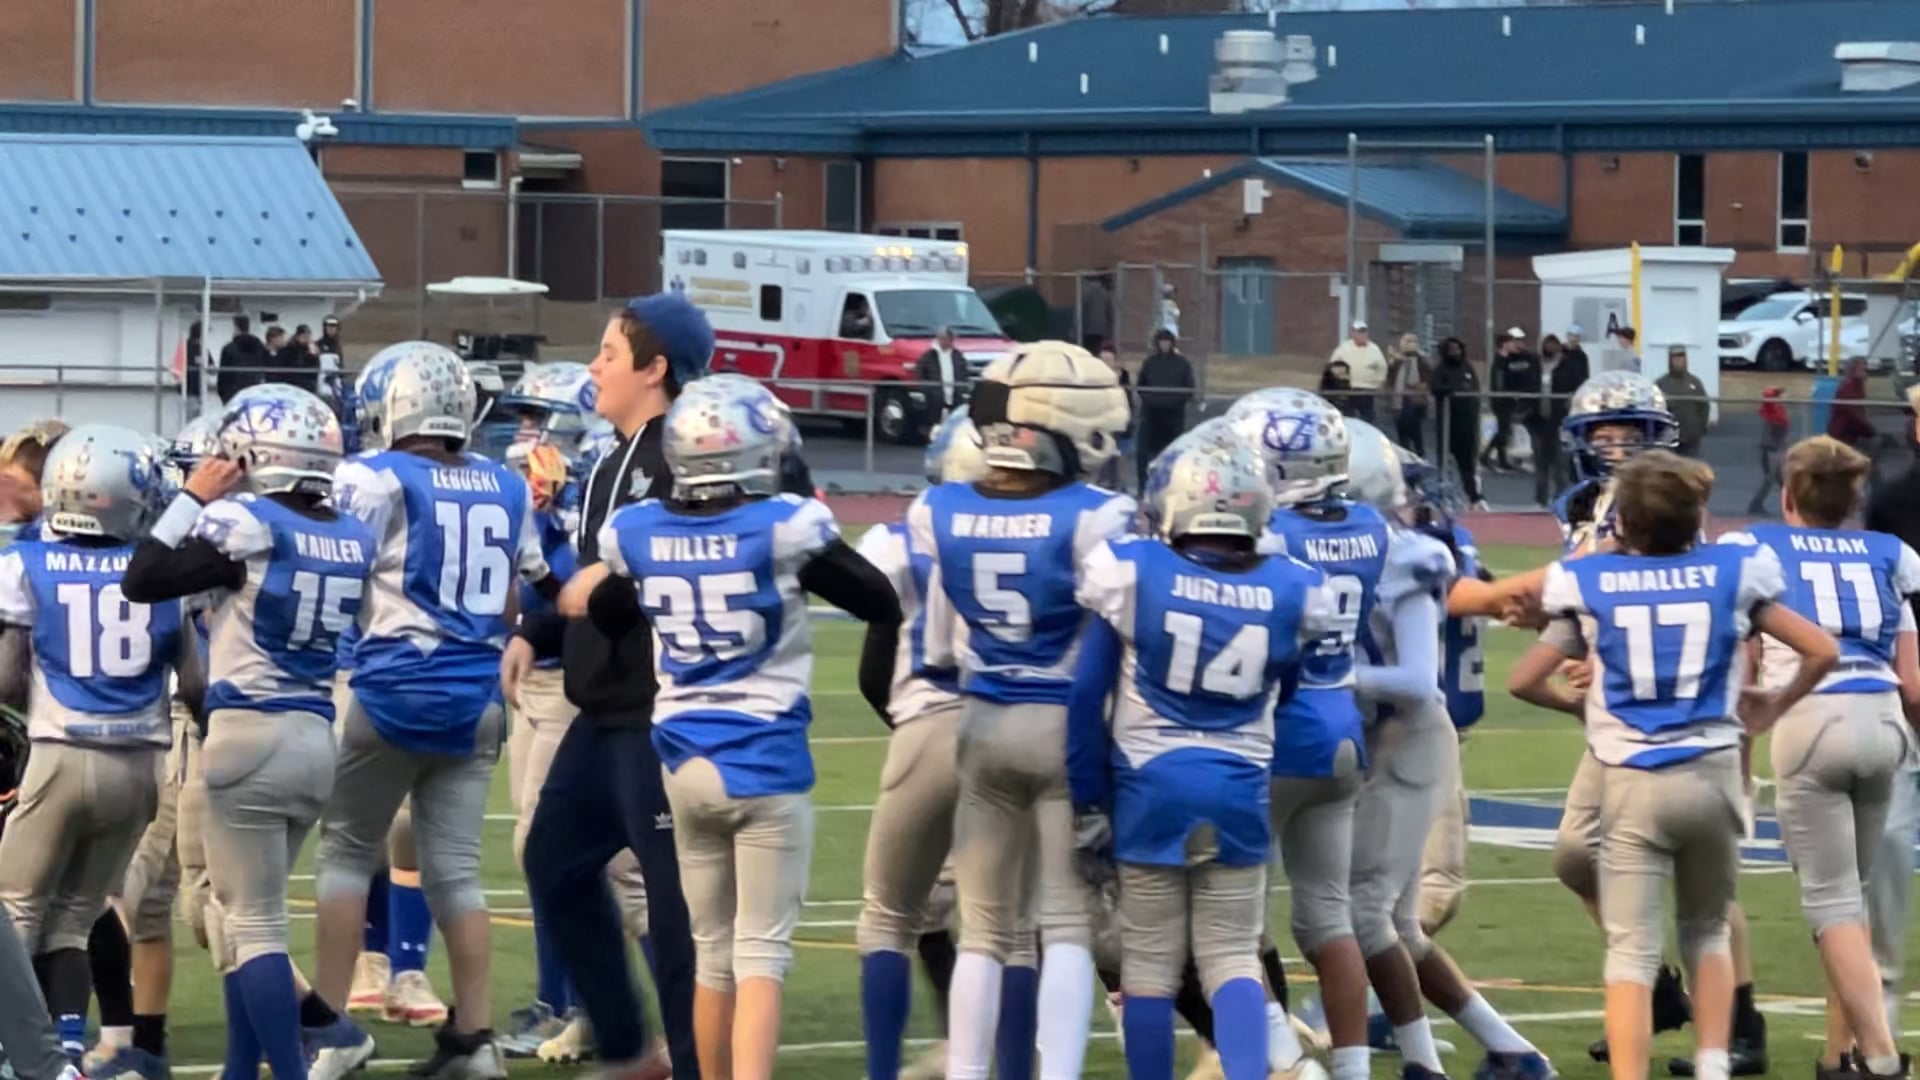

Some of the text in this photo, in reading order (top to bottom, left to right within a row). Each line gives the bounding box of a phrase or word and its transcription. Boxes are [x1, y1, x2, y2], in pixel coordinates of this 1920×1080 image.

[45, 551, 134, 573] MAZZU
[436, 500, 511, 616] 16
[650, 534, 737, 561] WILLEY
[951, 512, 1052, 538] WARNER
[1790, 534, 1868, 554] KOZAK
[287, 571, 363, 652] 15
[643, 571, 766, 664] 35
[973, 552, 1032, 642] 5
[1170, 574, 1274, 612] JURADO
[1600, 565, 1717, 593] OMALLEY
[1801, 562, 1884, 641] 11
[57, 583, 151, 677] 18
[1164, 611, 1269, 699] 14
[1615, 602, 1711, 700] 17
